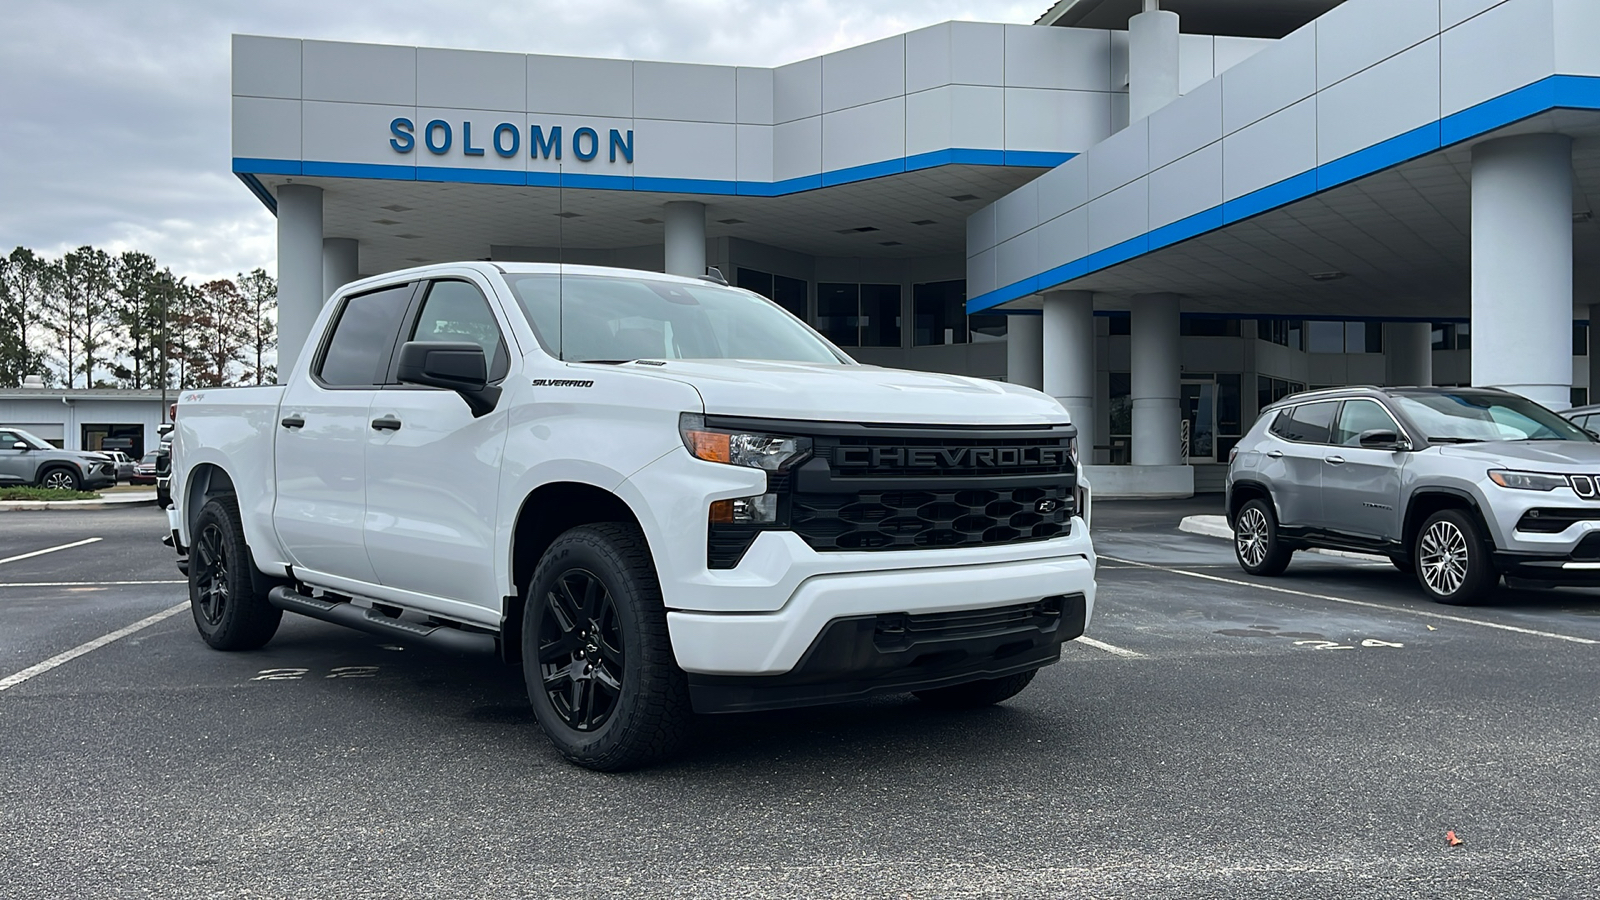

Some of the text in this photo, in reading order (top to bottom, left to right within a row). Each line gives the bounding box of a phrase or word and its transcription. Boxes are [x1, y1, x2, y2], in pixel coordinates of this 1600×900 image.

[390, 117, 634, 164] SOLOMON
[532, 379, 594, 388] SILVERADO
[836, 447, 1072, 467] CHEVROLET
[1293, 638, 1404, 650] 24
